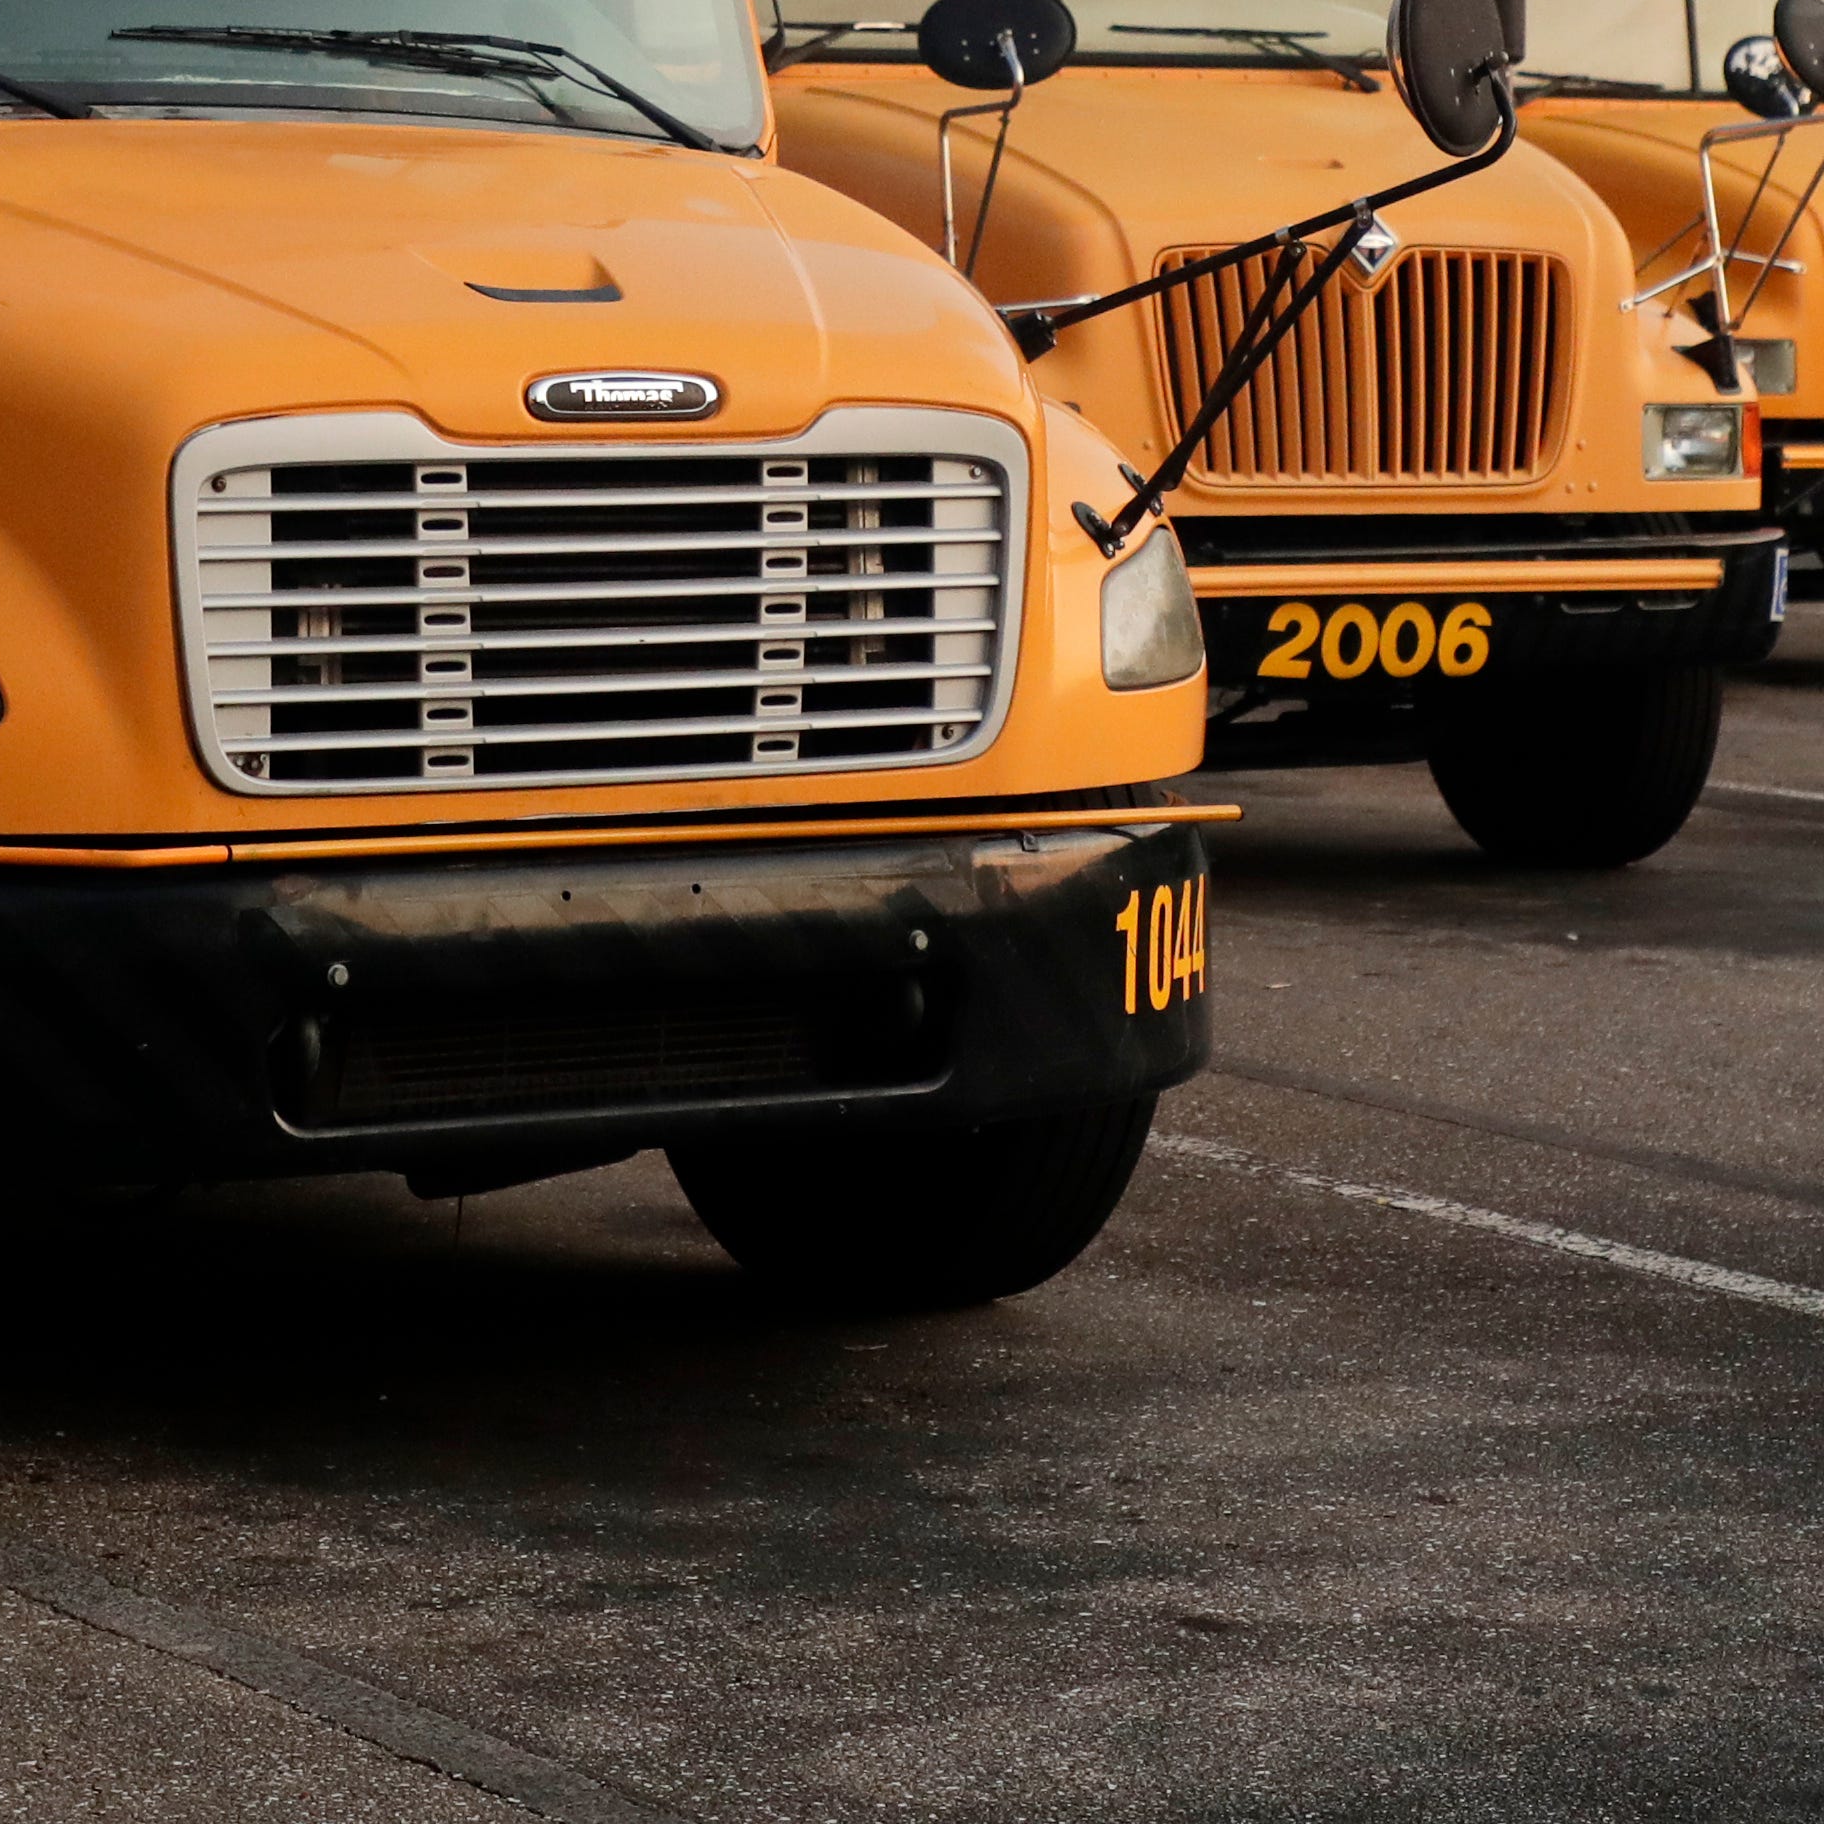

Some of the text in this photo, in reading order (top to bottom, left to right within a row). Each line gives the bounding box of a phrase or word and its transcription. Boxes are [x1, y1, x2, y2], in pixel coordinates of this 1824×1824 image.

[569, 379, 684, 403] Thomas
[1257, 602, 1493, 679] 2006
[1115, 873, 1205, 1015] 1044
